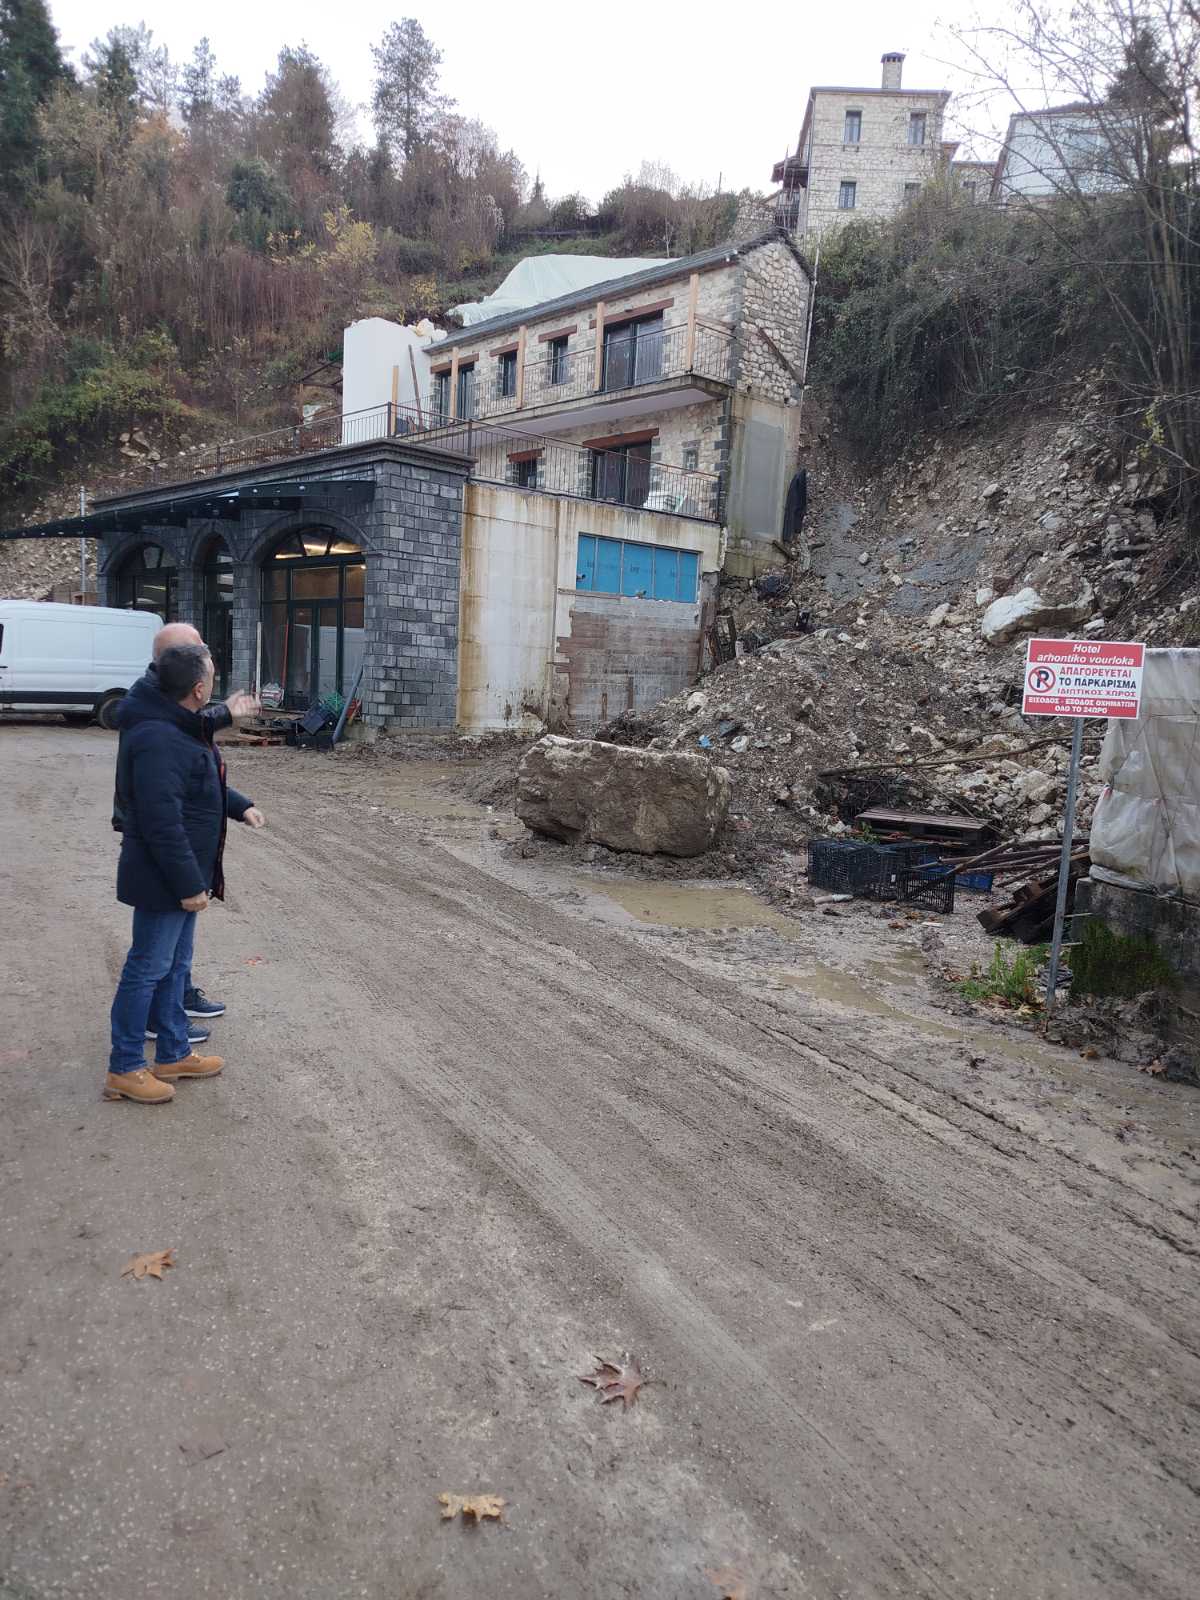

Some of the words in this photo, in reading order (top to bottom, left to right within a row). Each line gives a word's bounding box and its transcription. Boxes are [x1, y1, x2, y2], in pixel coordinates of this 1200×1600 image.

[1073, 644, 1101, 653] Hotel
[1037, 653, 1086, 663] arhontiko
[1090, 655, 1134, 665] vourloka
[1060, 667, 1131, 677] ΑΠΑΓΟΡΕΥΕΤΑΙ
[1074, 678, 1136, 689] ΠΑΡΚΑΡΙΣΜΑ
